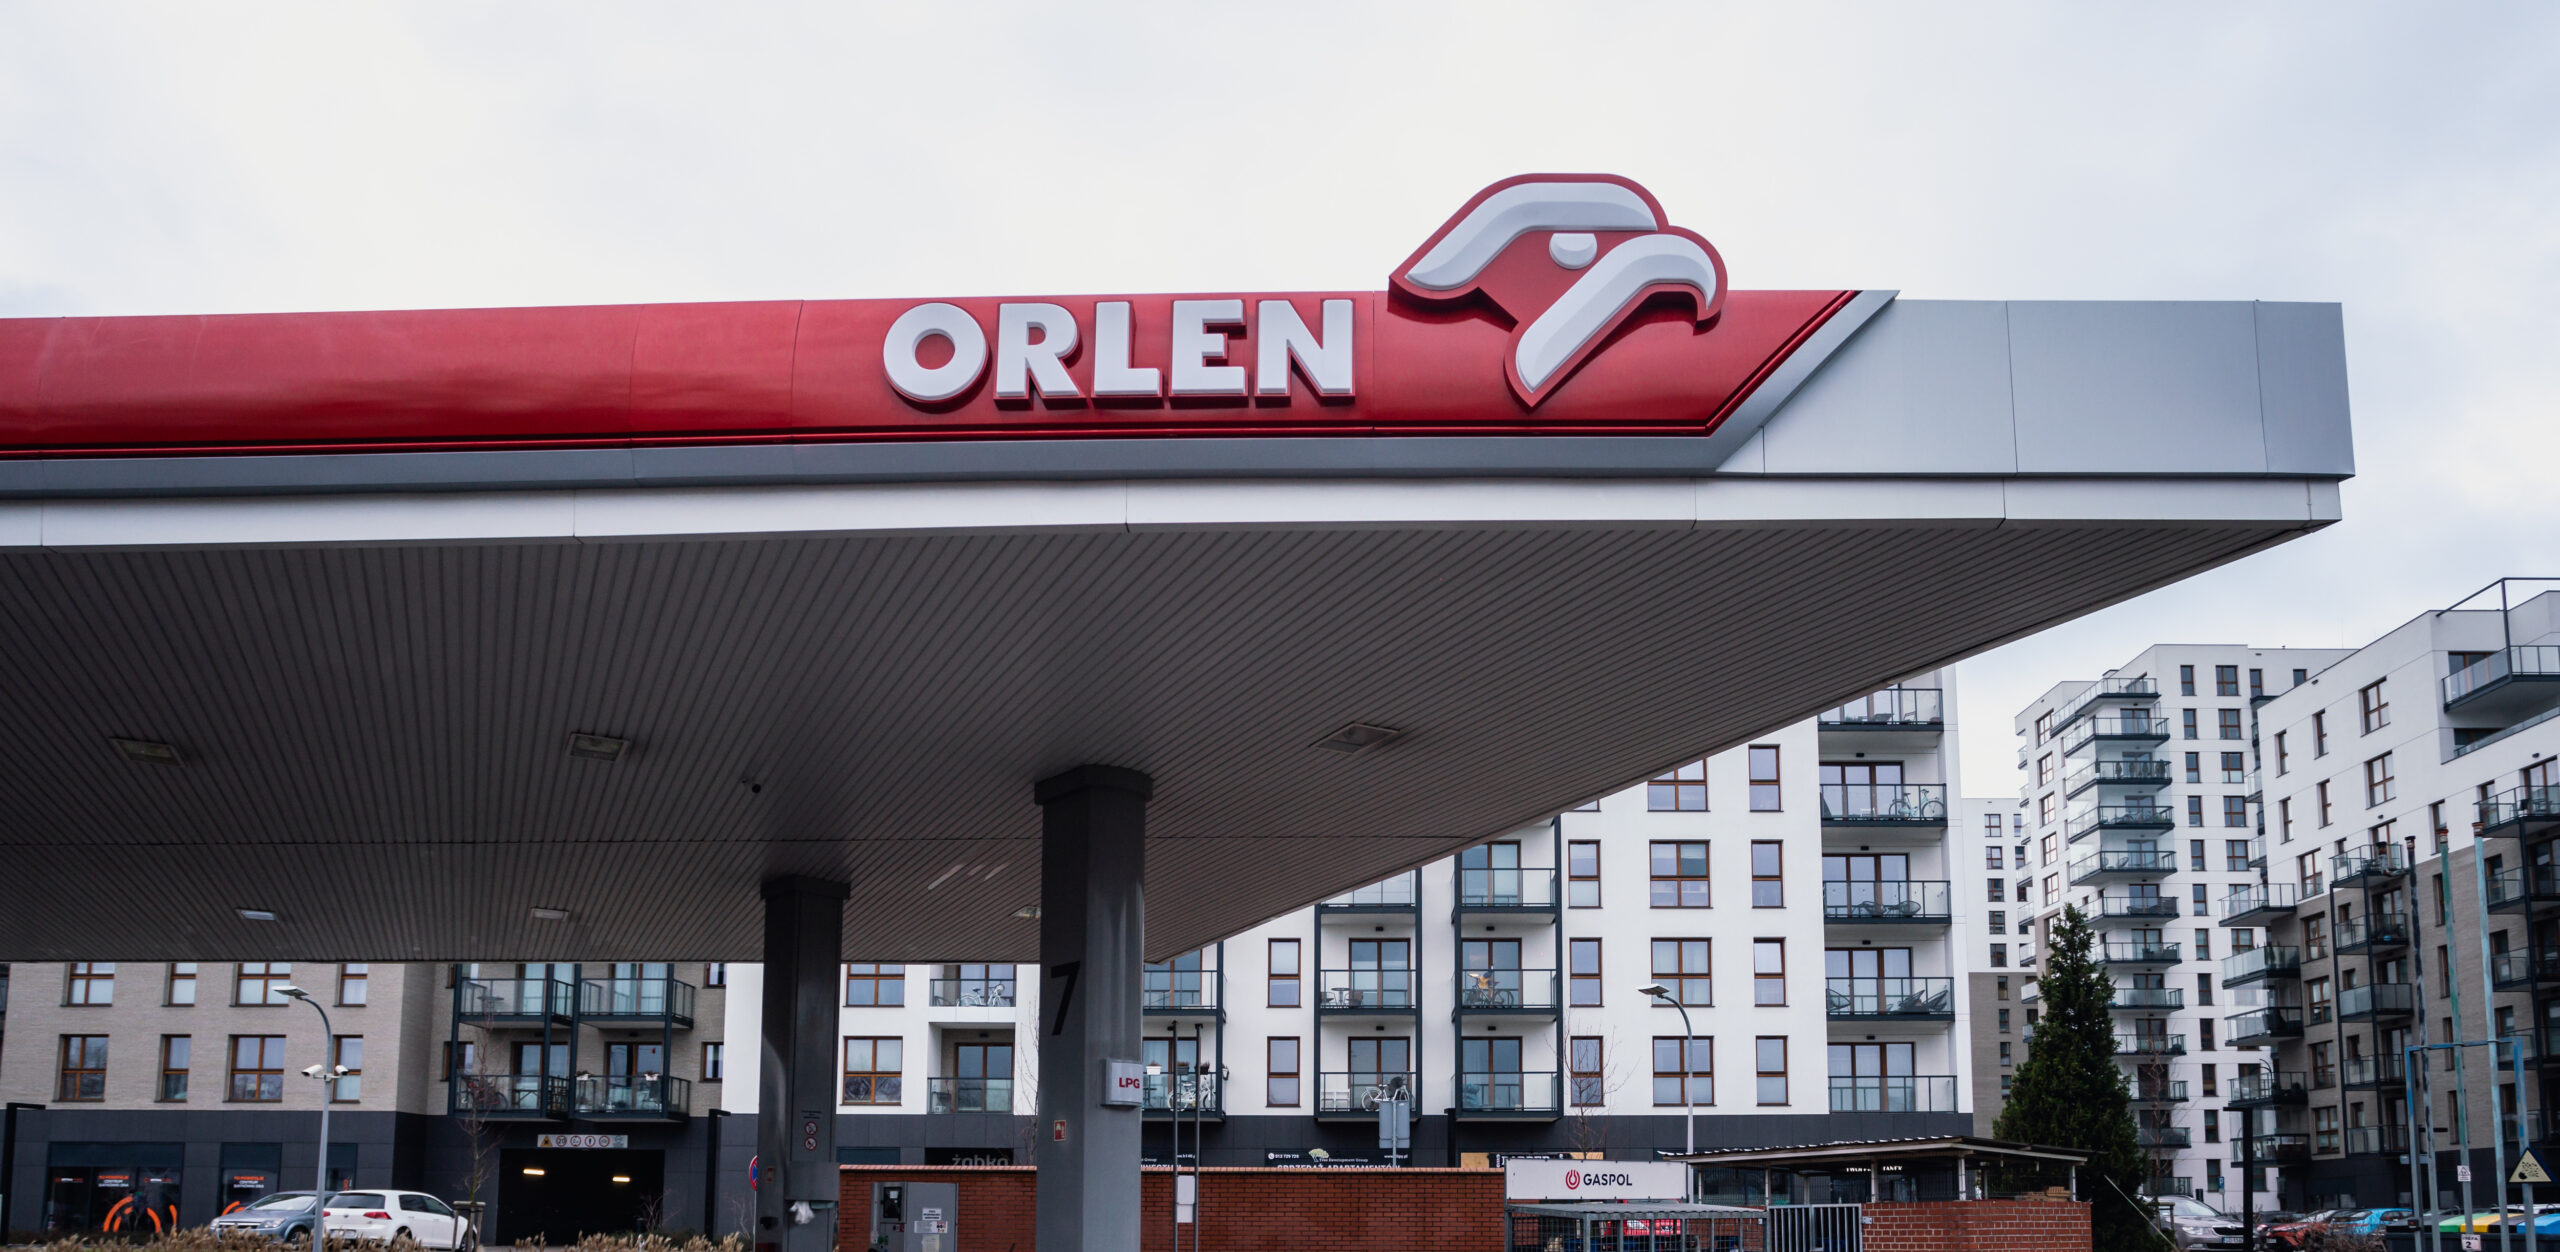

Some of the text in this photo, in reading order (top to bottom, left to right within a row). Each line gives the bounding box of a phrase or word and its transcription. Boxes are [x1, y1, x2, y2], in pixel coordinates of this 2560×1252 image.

[883, 299, 1355, 401] ORLEN
[1051, 961, 1081, 1036] 7
[1118, 1077, 1140, 1089] LPG
[952, 1154, 1009, 1166] żabka
[1583, 1173, 1633, 1186] GASPOL
[2465, 1241, 2472, 1249] 2
